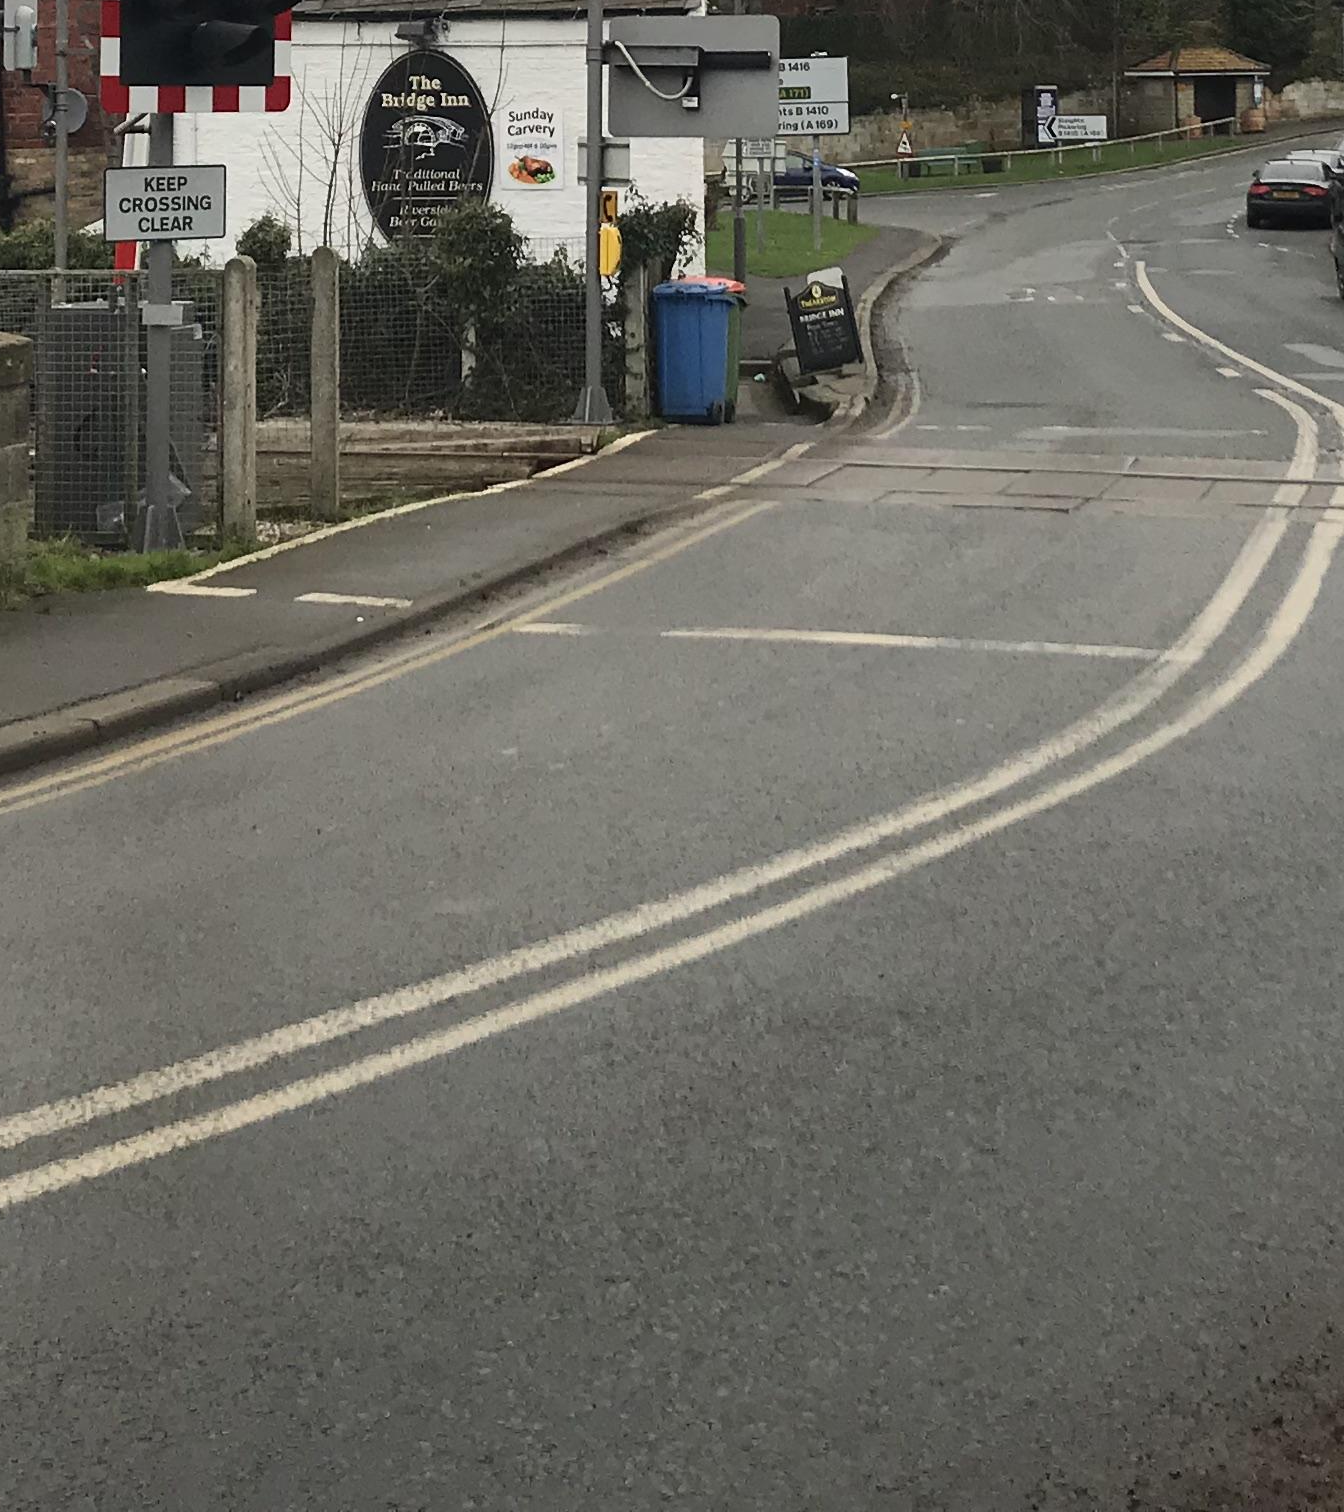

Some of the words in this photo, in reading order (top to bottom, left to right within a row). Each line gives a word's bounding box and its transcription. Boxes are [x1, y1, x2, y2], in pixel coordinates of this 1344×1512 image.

[408, 74, 442, 90] The
[381, 92, 436, 112] Bridge
[440, 92, 473, 107] Inn
[508, 106, 554, 124] Sunday
[507, 124, 556, 139] Carvery
[144, 176, 188, 192] KEEP
[407, 180, 446, 192] Pulled
[119, 195, 212, 213] CROSSING
[138, 216, 193, 233] CLEAR
